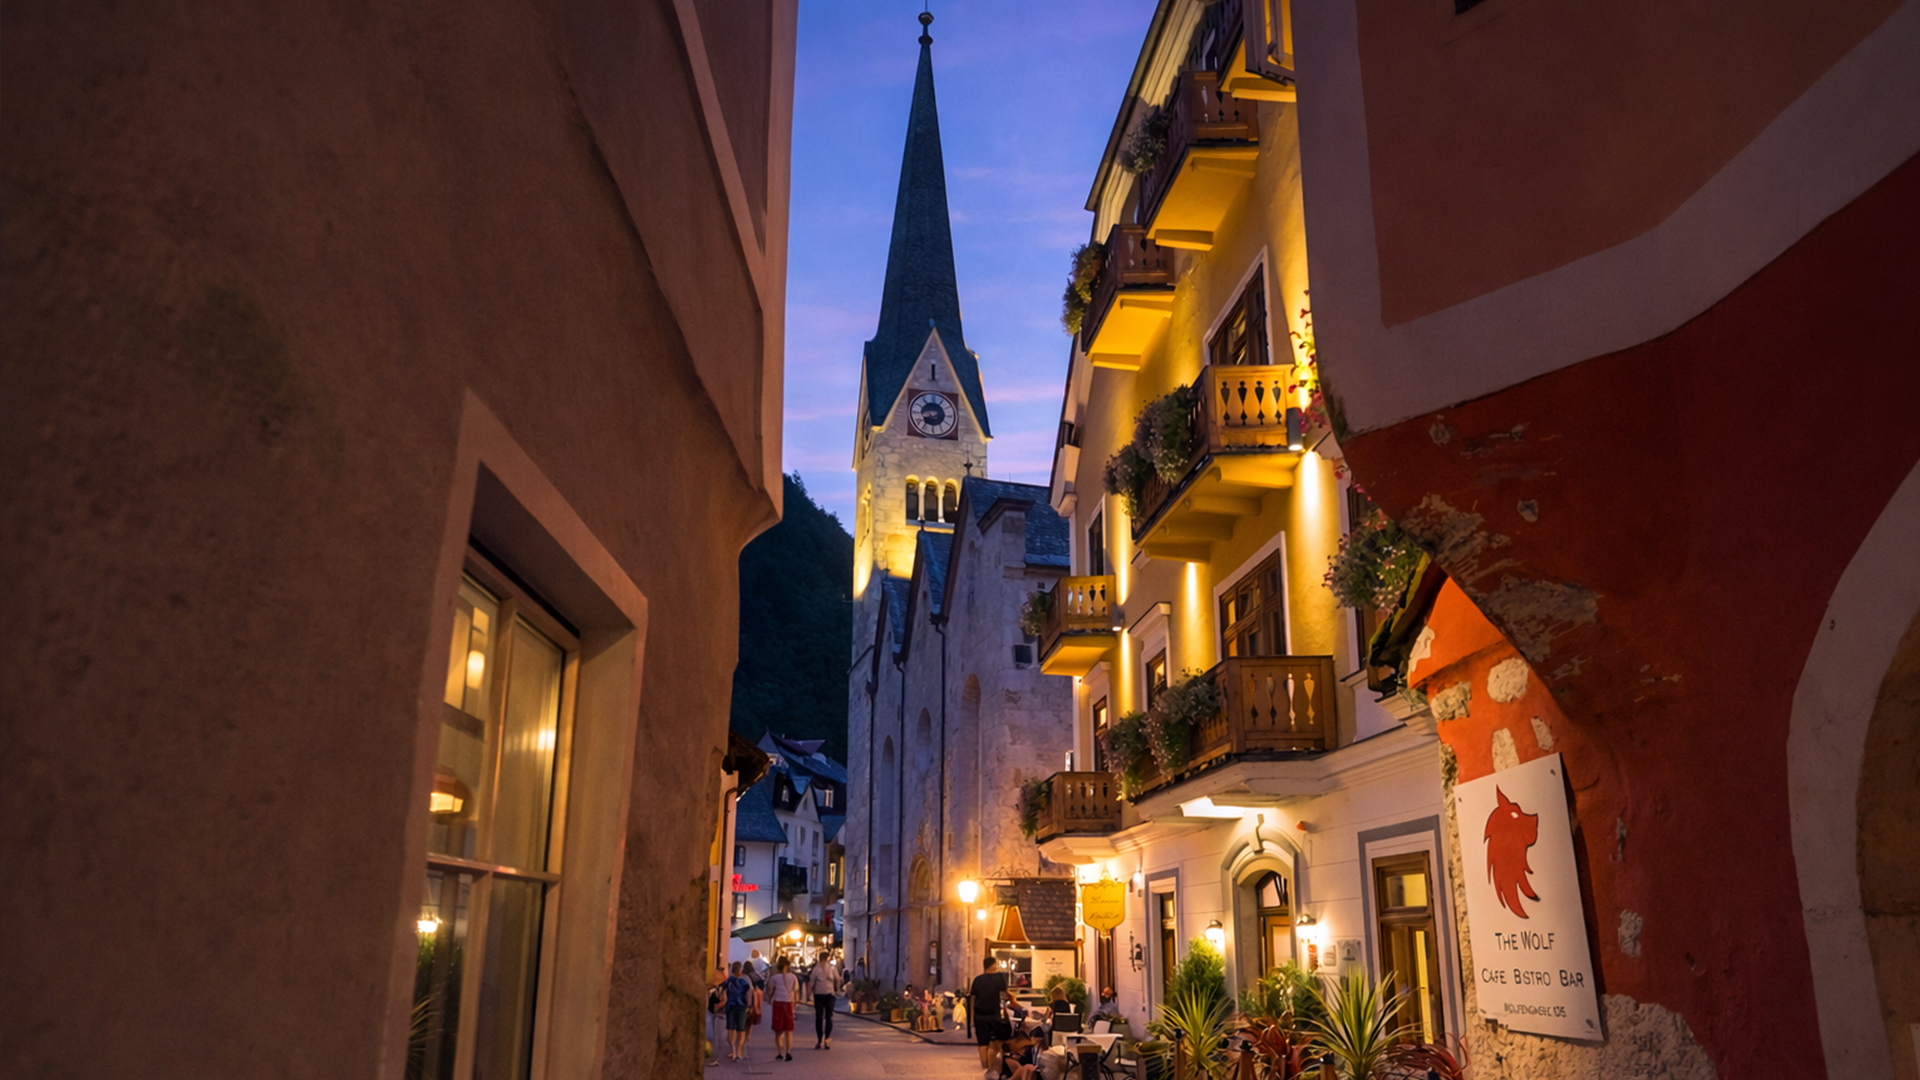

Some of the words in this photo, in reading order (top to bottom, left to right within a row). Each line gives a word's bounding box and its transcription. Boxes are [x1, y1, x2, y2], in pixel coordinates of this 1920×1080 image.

[1494, 932, 1519, 951] THE
[1520, 930, 1555, 951] WOLF
[1559, 969, 1586, 988] BAR
